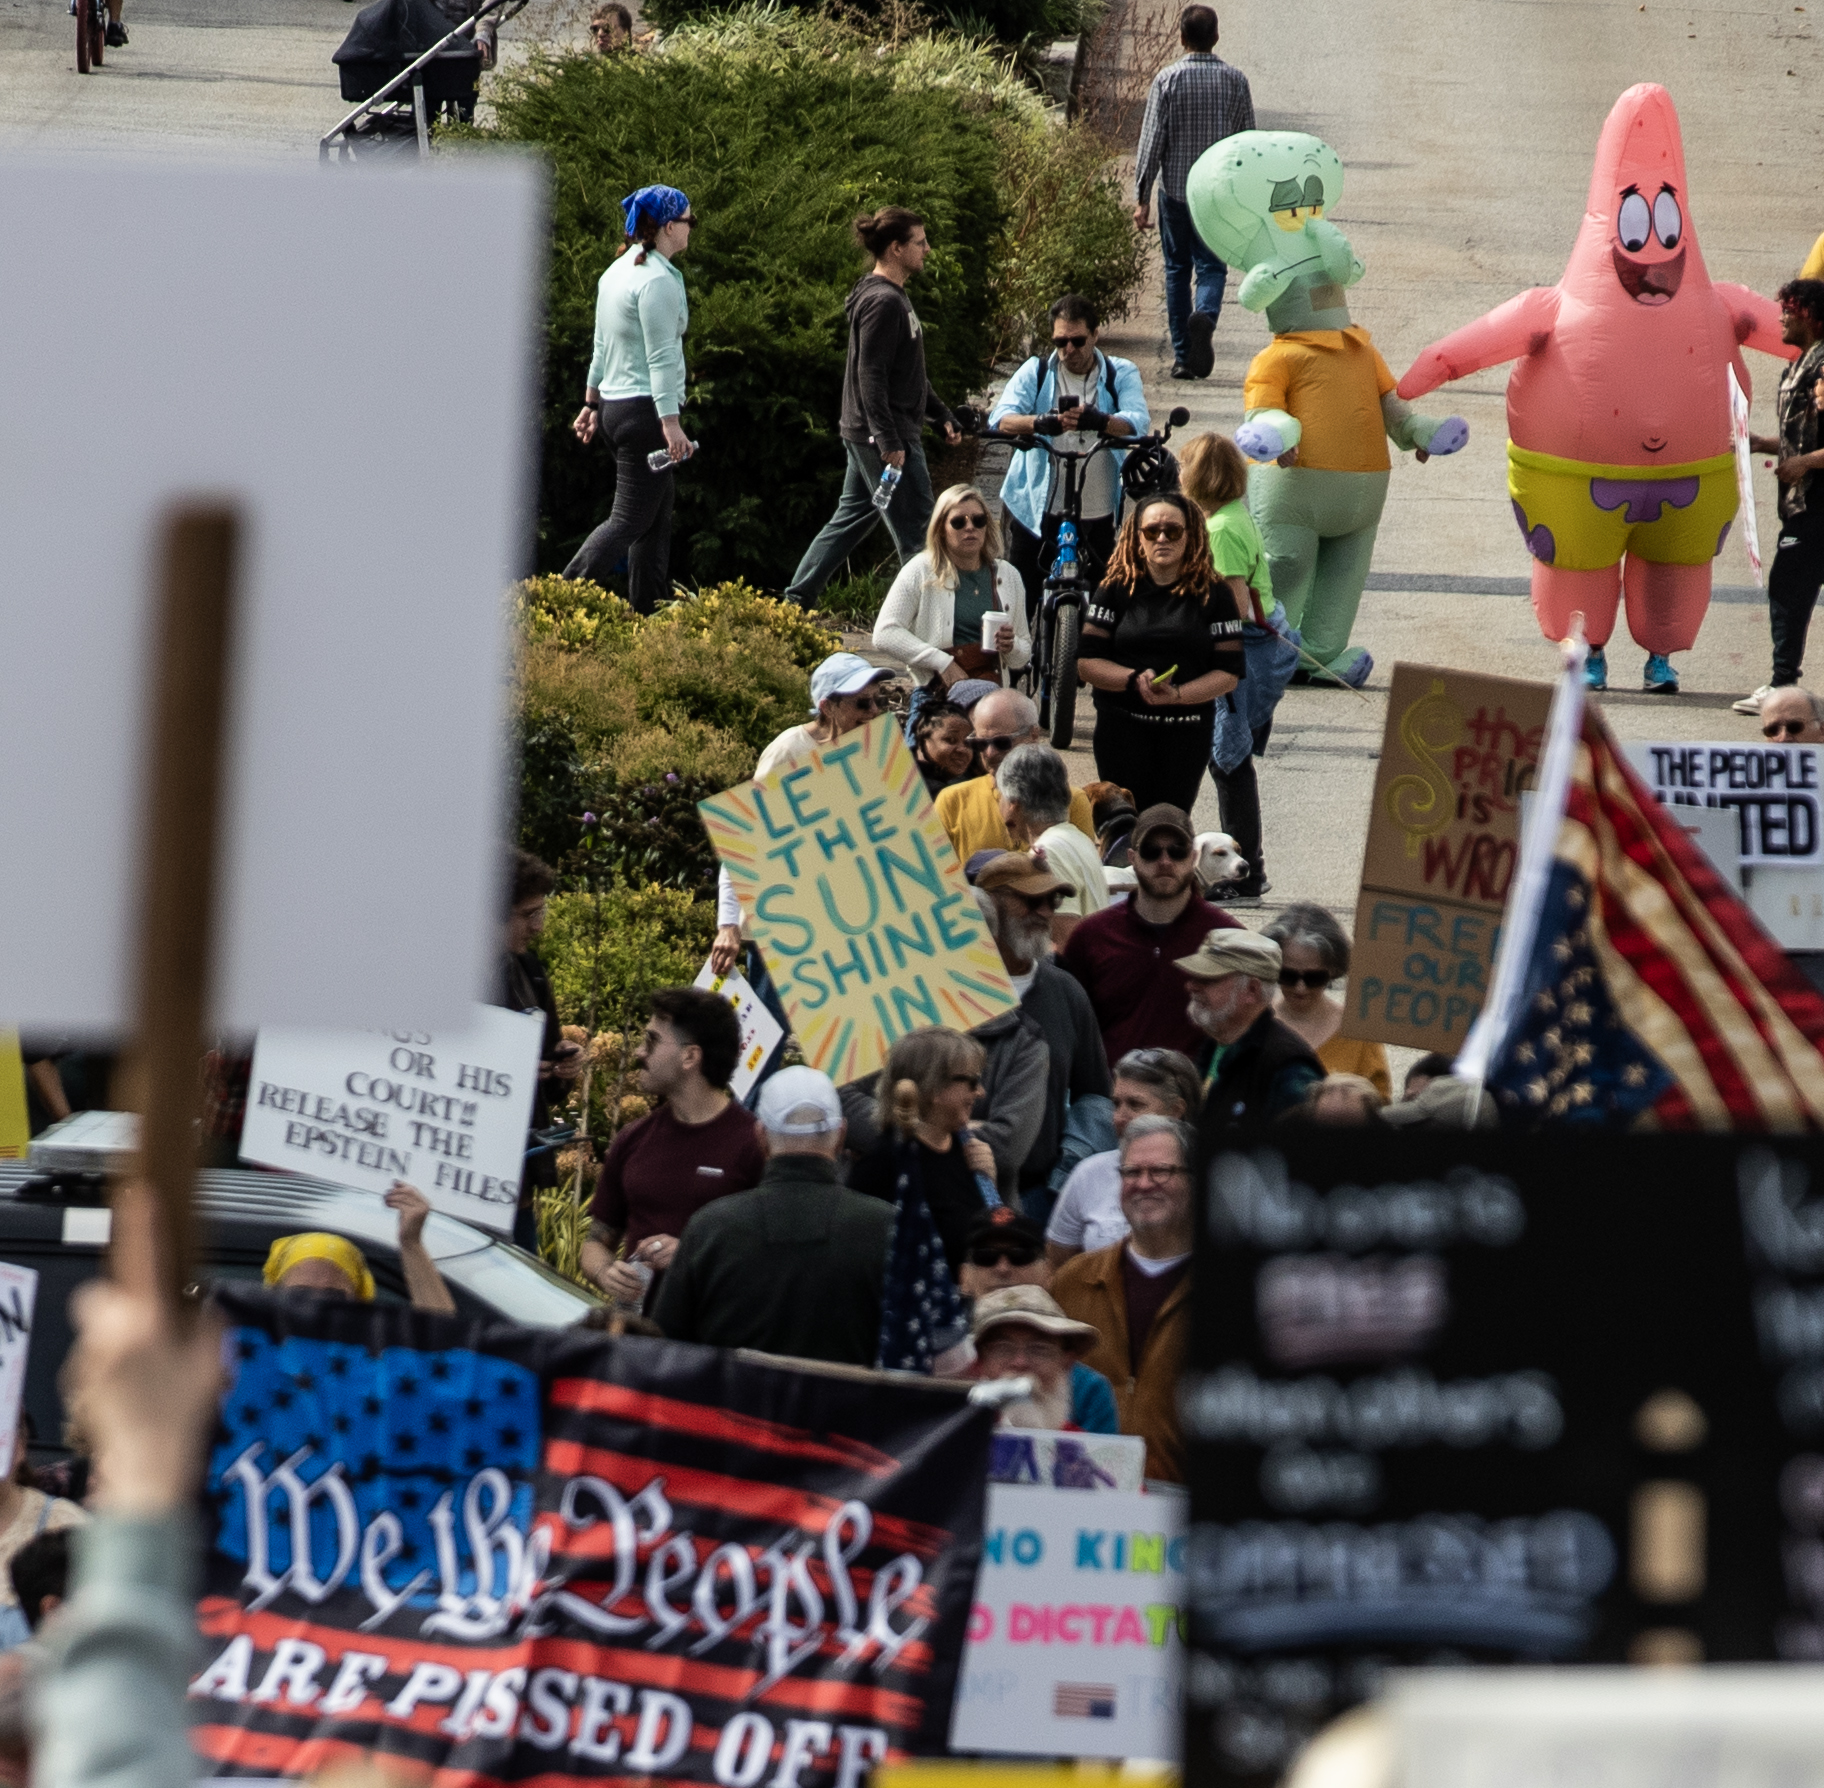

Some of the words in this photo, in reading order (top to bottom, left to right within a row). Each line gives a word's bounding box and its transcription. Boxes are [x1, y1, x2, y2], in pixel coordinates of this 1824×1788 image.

[752, 741, 865, 839] LET
[1456, 782, 1491, 824] is
[1650, 747, 1705, 788] THE
[1709, 749, 1819, 789] PEOPLE
[765, 796, 900, 877] THE
[1422, 832, 1519, 902] WRO
[755, 829, 947, 957] SUN
[792, 892, 978, 1010] SHINE
[1403, 952, 1489, 993] OUR
[872, 975, 942, 1044] IN
[1359, 975, 1478, 1032] PEOP
[389, 1046, 435, 1080] OR
[457, 1062, 513, 1097] HIS
[257, 1080, 391, 1139] RELEASE
[409, 1119, 474, 1160] THE
[283, 1119, 412, 1175] EPSTEIN
[433, 1159, 520, 1205] FILES
[222, 1442, 433, 1632] We
[420, 1466, 566, 1640] the
[522, 1475, 930, 1702] People
[187, 1633, 388, 1716] ARE
[384, 1660, 694, 1773] PISSED
